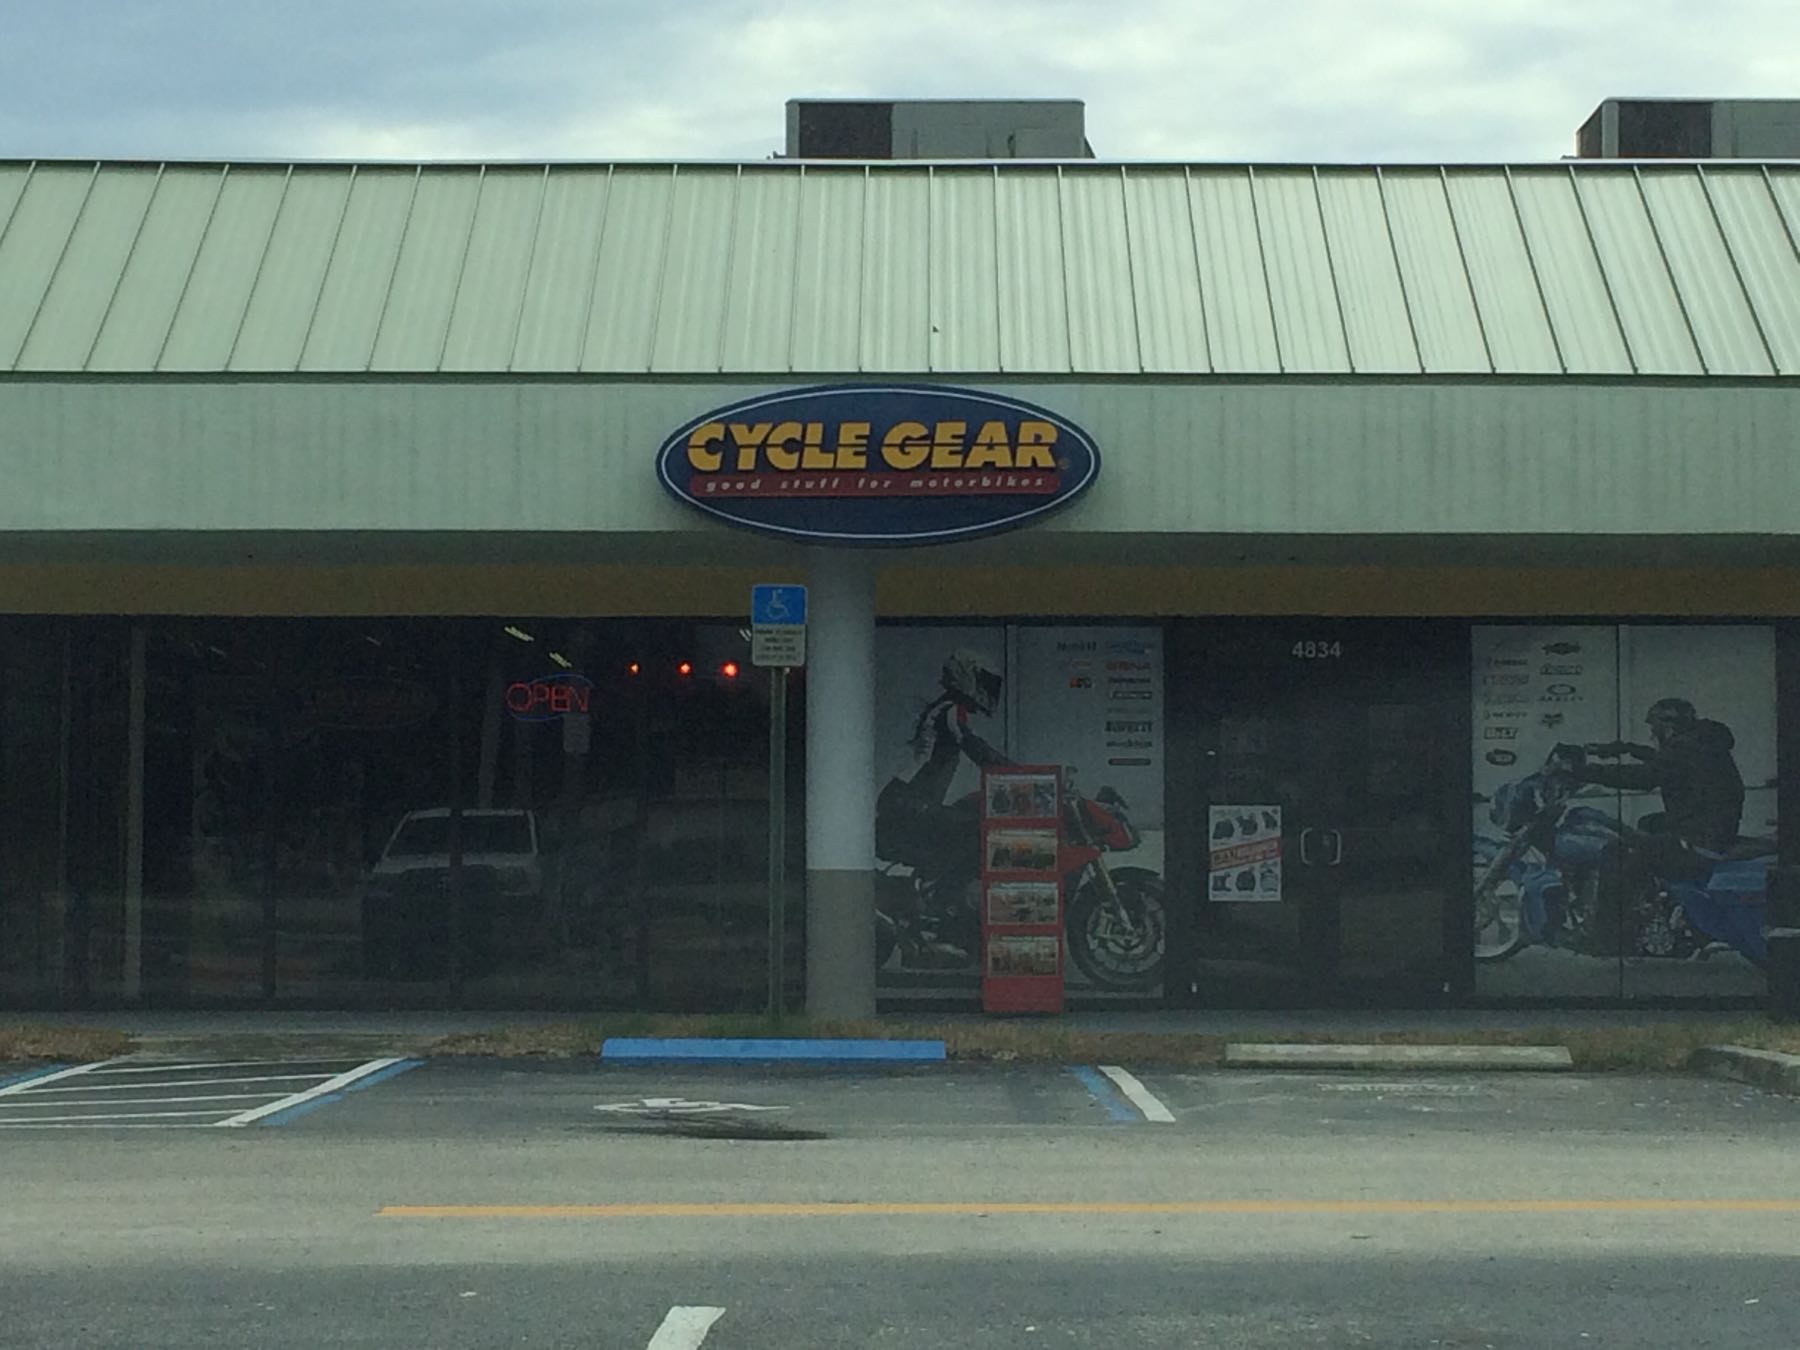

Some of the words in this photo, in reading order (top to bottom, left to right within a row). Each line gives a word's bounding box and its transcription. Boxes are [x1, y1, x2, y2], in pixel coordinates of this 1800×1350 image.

[687, 421, 870, 472] CYCLE
[880, 420, 1057, 471] GEAR
[705, 479, 761, 492] good
[780, 477, 839, 489] stuff
[857, 477, 892, 489] for
[910, 476, 1043, 488] motorbikes
[1291, 641, 1341, 659] 4834
[506, 683, 590, 712] OPEN
